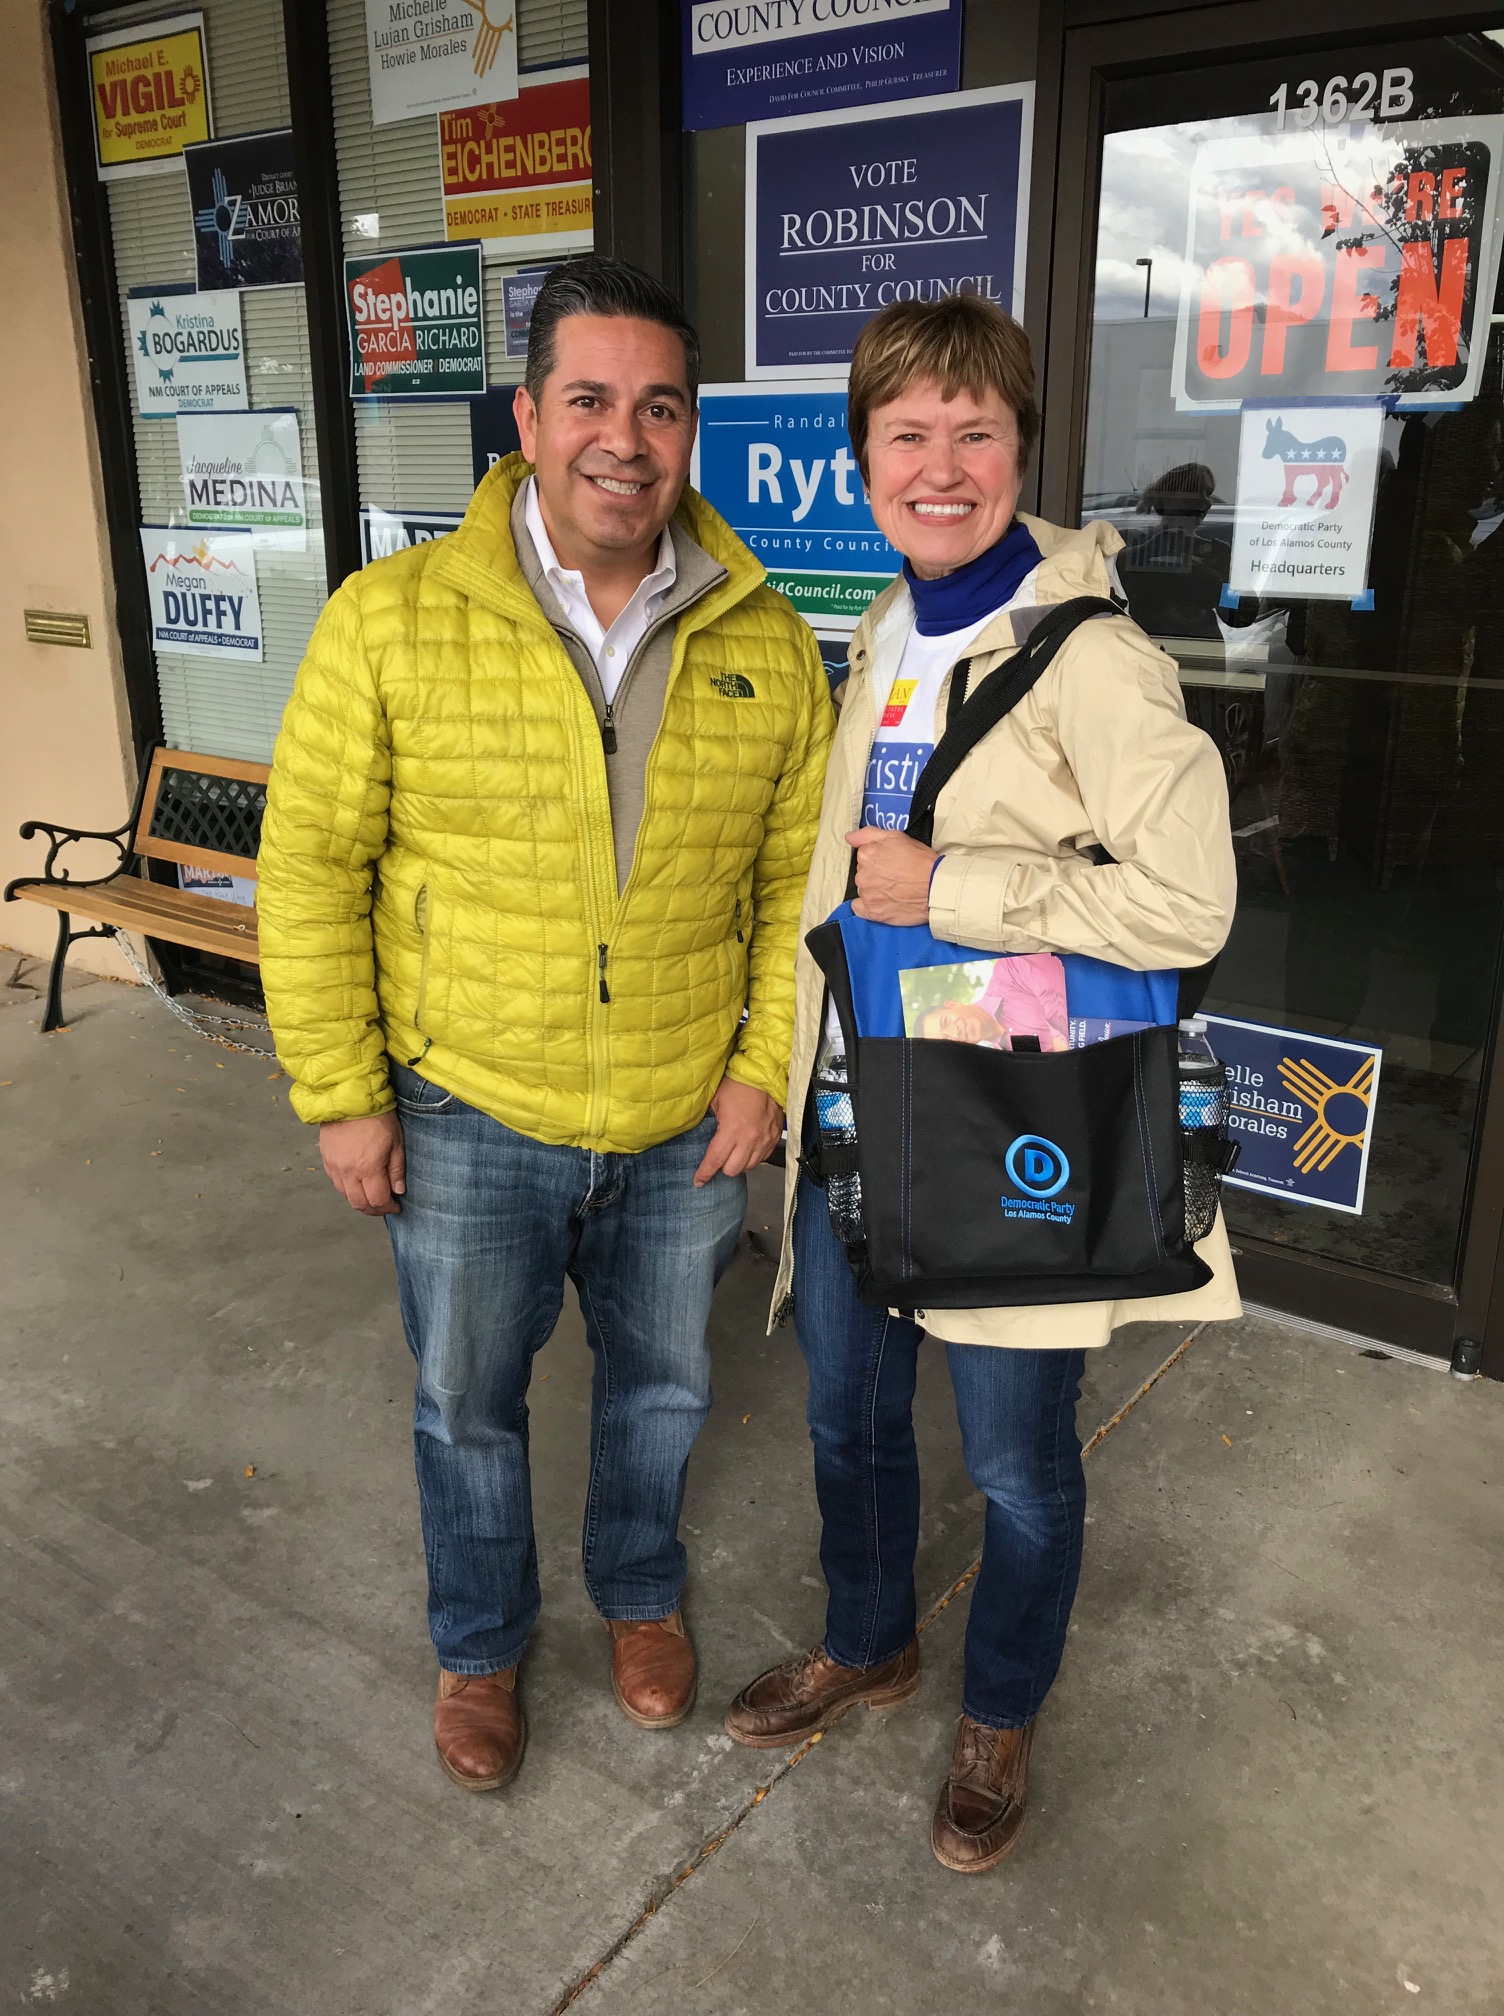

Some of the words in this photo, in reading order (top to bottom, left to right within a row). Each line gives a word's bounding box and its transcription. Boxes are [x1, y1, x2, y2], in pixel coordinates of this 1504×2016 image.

[389, 0, 447, 22] Michelle
[697, 0, 803, 43] COUNTY
[373, 27, 410, 49] Lujan
[413, 12, 474, 39] Grisham
[105, 53, 151, 77] Michael
[157, 50, 169, 67] E.
[380, 49, 416, 70] Howie
[420, 38, 467, 62] Morales
[726, 57, 813, 87] EXPERIENCE
[816, 51, 848, 71] AND
[851, 41, 905, 65] VISION
[97, 69, 185, 120] VIGIL
[1269, 66, 1414, 130] 1362B
[102, 126, 113, 139] for
[115, 116, 158, 139] Supreme
[160, 111, 187, 131] Court
[440, 113, 473, 140] Tim
[135, 137, 172, 150] DEMOCRAT
[849, 158, 918, 189] VOTE
[251, 183, 274, 199] JUDGE
[446, 207, 499, 227] DEMOCRAT
[511, 203, 541, 221] STATE
[545, 197, 593, 217] TREASUR
[780, 193, 989, 249] ROBINSON
[256, 229, 279, 241] COURT
[281, 228, 290, 237] OF
[861, 253, 896, 272] FOR
[353, 275, 477, 331] Stephanie
[765, 283, 871, 313] COUNTY
[1196, 236, 1469, 380] OPEN
[175, 314, 214, 330] Kristina
[152, 328, 240, 355] BOGARDUS
[416, 327, 479, 350] RICHARD
[354, 361, 375, 376] LAND
[376, 359, 433, 376] COMMISSIONER
[439, 357, 482, 372] DEMOCRAT
[149, 386, 163, 397] NM
[164, 385, 190, 397] COURT
[191, 384, 203, 396] OF
[205, 383, 240, 396] APPEALS
[178, 398, 214, 408] DEMOCRAT
[774, 413, 845, 429] Randal
[186, 454, 243, 479] Jacqueline
[188, 479, 299, 508] MEDINA
[748, 442, 871, 523] Ryt
[244, 514, 264, 522] COURT
[272, 515, 300, 523] APPEALS
[1261, 521, 1315, 532] Democratic
[1317, 522, 1343, 534] Party
[750, 535, 812, 552] County
[823, 537, 897, 552] Counci
[1249, 537, 1259, 546] of
[1261, 538, 1277, 547] Los
[1280, 538, 1315, 548] Alamos
[1317, 539, 1352, 551] County
[1250, 560, 1345, 577] Headquarters
[165, 572, 206, 592] Megan
[162, 590, 243, 631] DUFFY
[158, 630, 170, 639] NM
[170, 631, 188, 640] COURT
[195, 634, 218, 644] APPEALS
[222, 636, 255, 647] DEMOCRAT
[710, 677, 737, 690] NORTH
[721, 672, 736, 682] THE
[719, 688, 740, 698] FACE
[1229, 1086, 1303, 1120] isham
[1024, 1148, 1054, 1182] D
[1001, 1196, 1050, 1212] Democratic
[1051, 1201, 1075, 1216] Party
[1004, 1208, 1017, 1218] Los
[1018, 1209, 1045, 1219] Alamos
[1046, 1212, 1072, 1224] County
